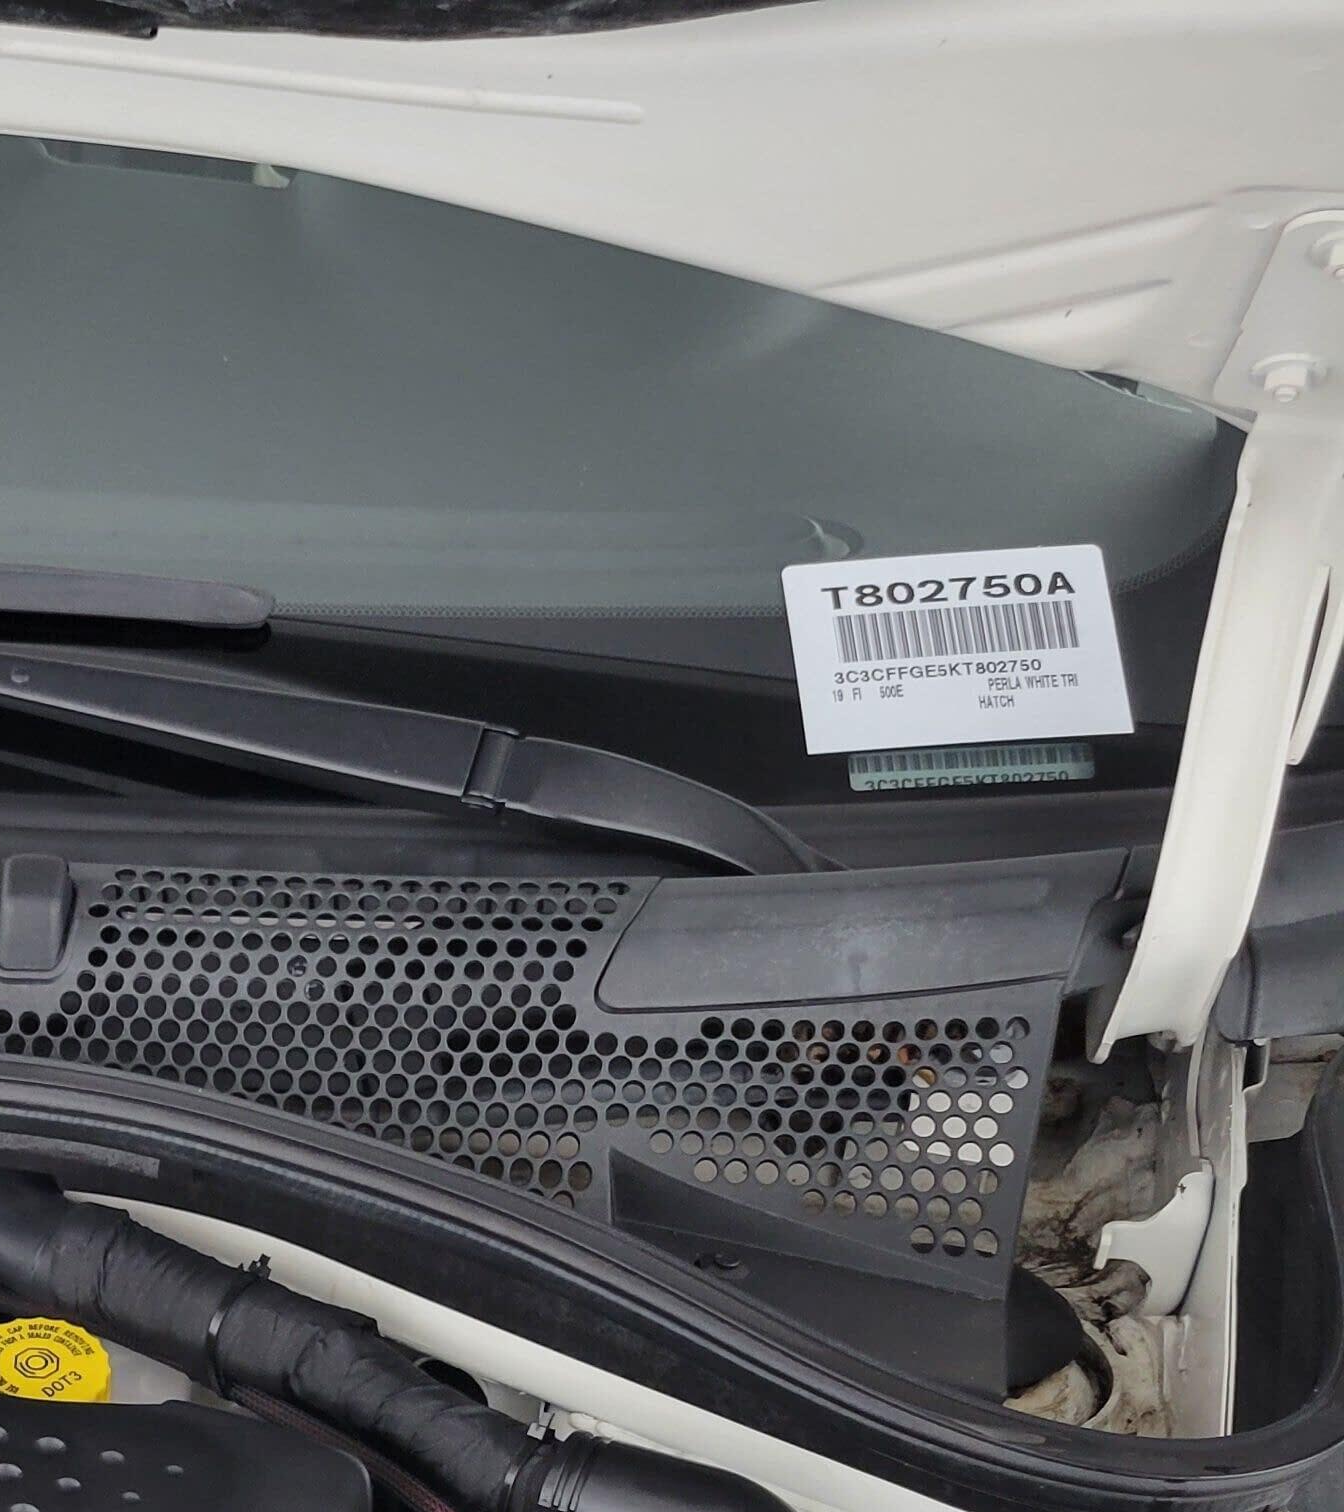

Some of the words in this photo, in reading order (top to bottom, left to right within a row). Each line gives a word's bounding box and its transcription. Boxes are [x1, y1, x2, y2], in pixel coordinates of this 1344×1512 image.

[820, 571, 1076, 611] T802750A
[833, 658, 1043, 685] 3C3CFFGE5KT802750
[988, 677, 1022, 691] PERLA
[1025, 675, 1059, 689] WHITE
[1060, 673, 1079, 688] TRI
[832, 690, 844, 703] 19
[852, 687, 863, 701] FI
[879, 685, 905, 700] 500E
[978, 695, 1015, 710] HATCH
[7, 1325, 23, 1335] CAP
[28, 1323, 60, 1334] BEFORE
[40, 1370, 83, 1399] DOT3
